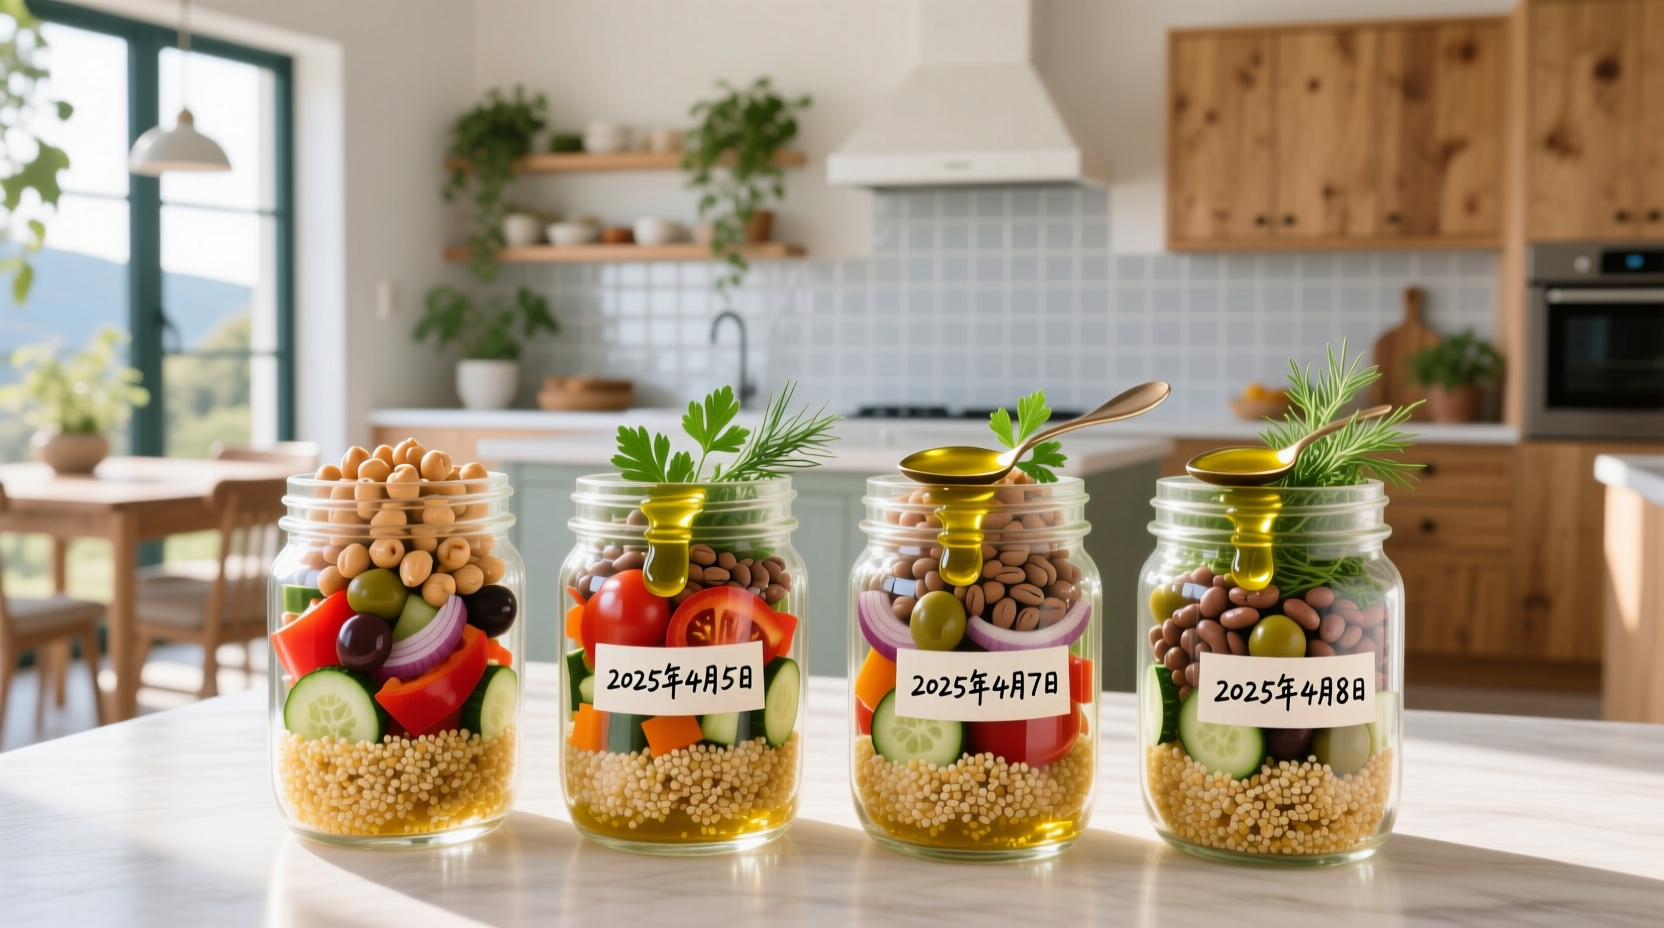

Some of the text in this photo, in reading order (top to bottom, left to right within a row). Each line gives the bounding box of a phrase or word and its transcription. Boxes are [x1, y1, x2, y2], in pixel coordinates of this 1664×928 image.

[606, 662, 752, 700] 2025年4月5日
[910, 668, 1058, 707] 2025年4月7日
[1213, 673, 1365, 712] 2025年4月8日
